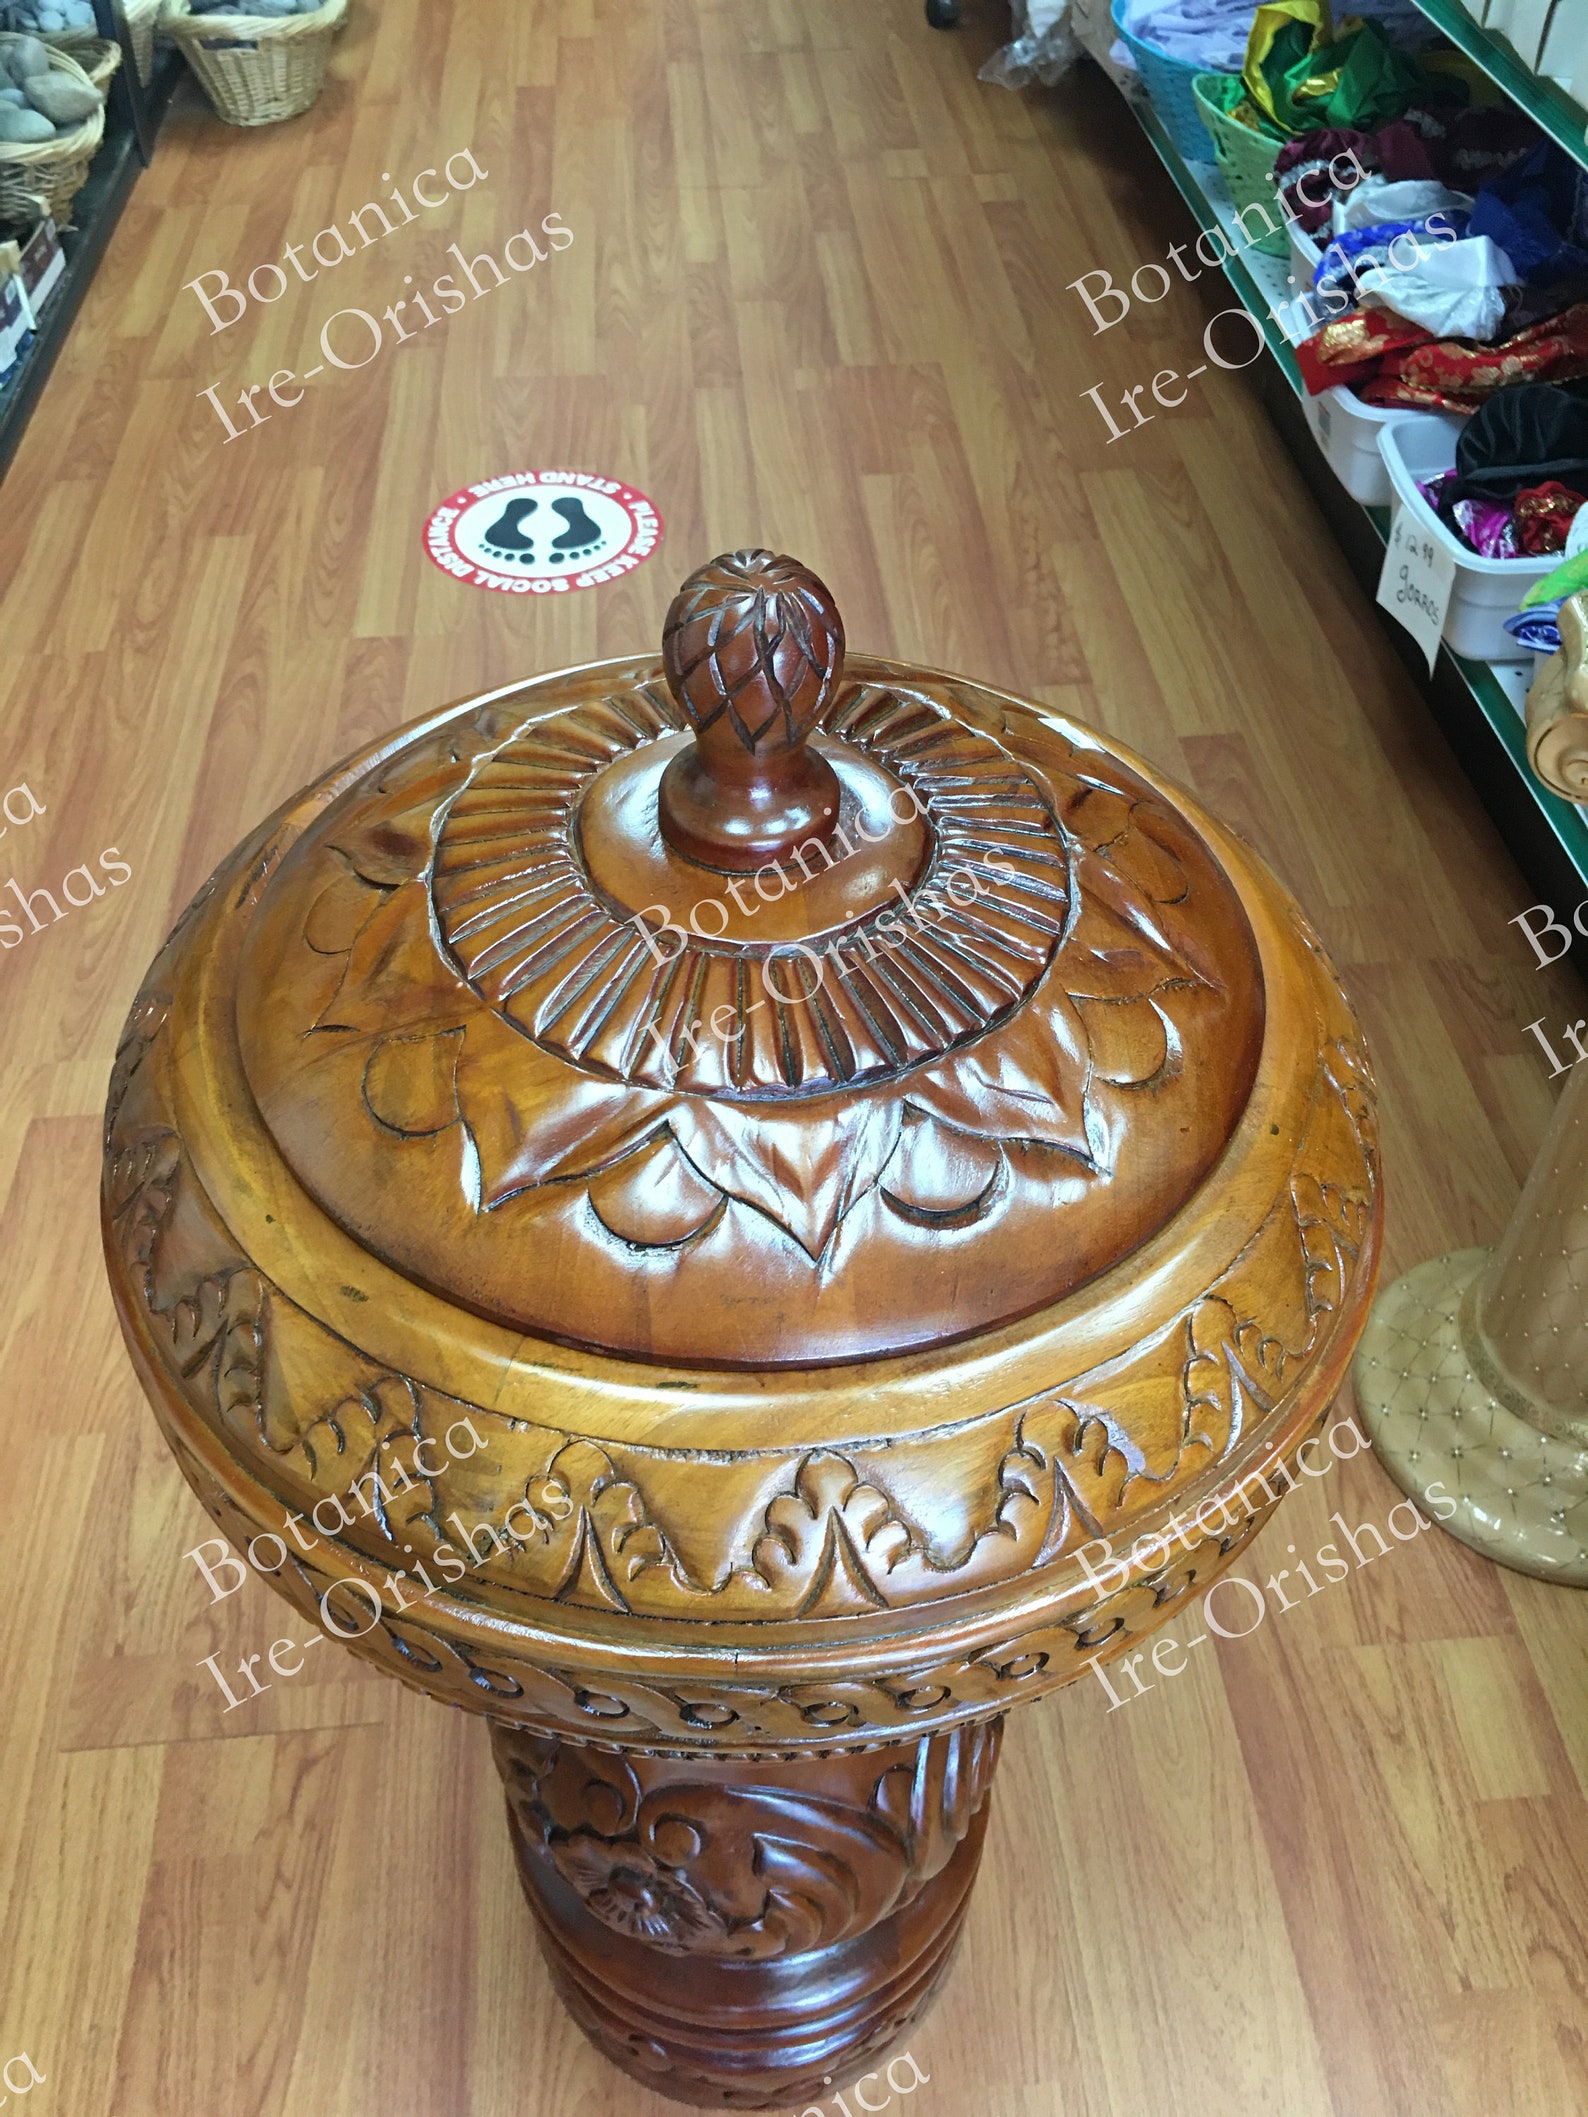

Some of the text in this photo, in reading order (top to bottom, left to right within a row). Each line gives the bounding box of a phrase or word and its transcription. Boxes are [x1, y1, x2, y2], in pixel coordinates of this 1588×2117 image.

[468, 472, 622, 498] STAND HERE
[428, 501, 659, 593] PLEASE KEEP SOCIAL DISTANCE
